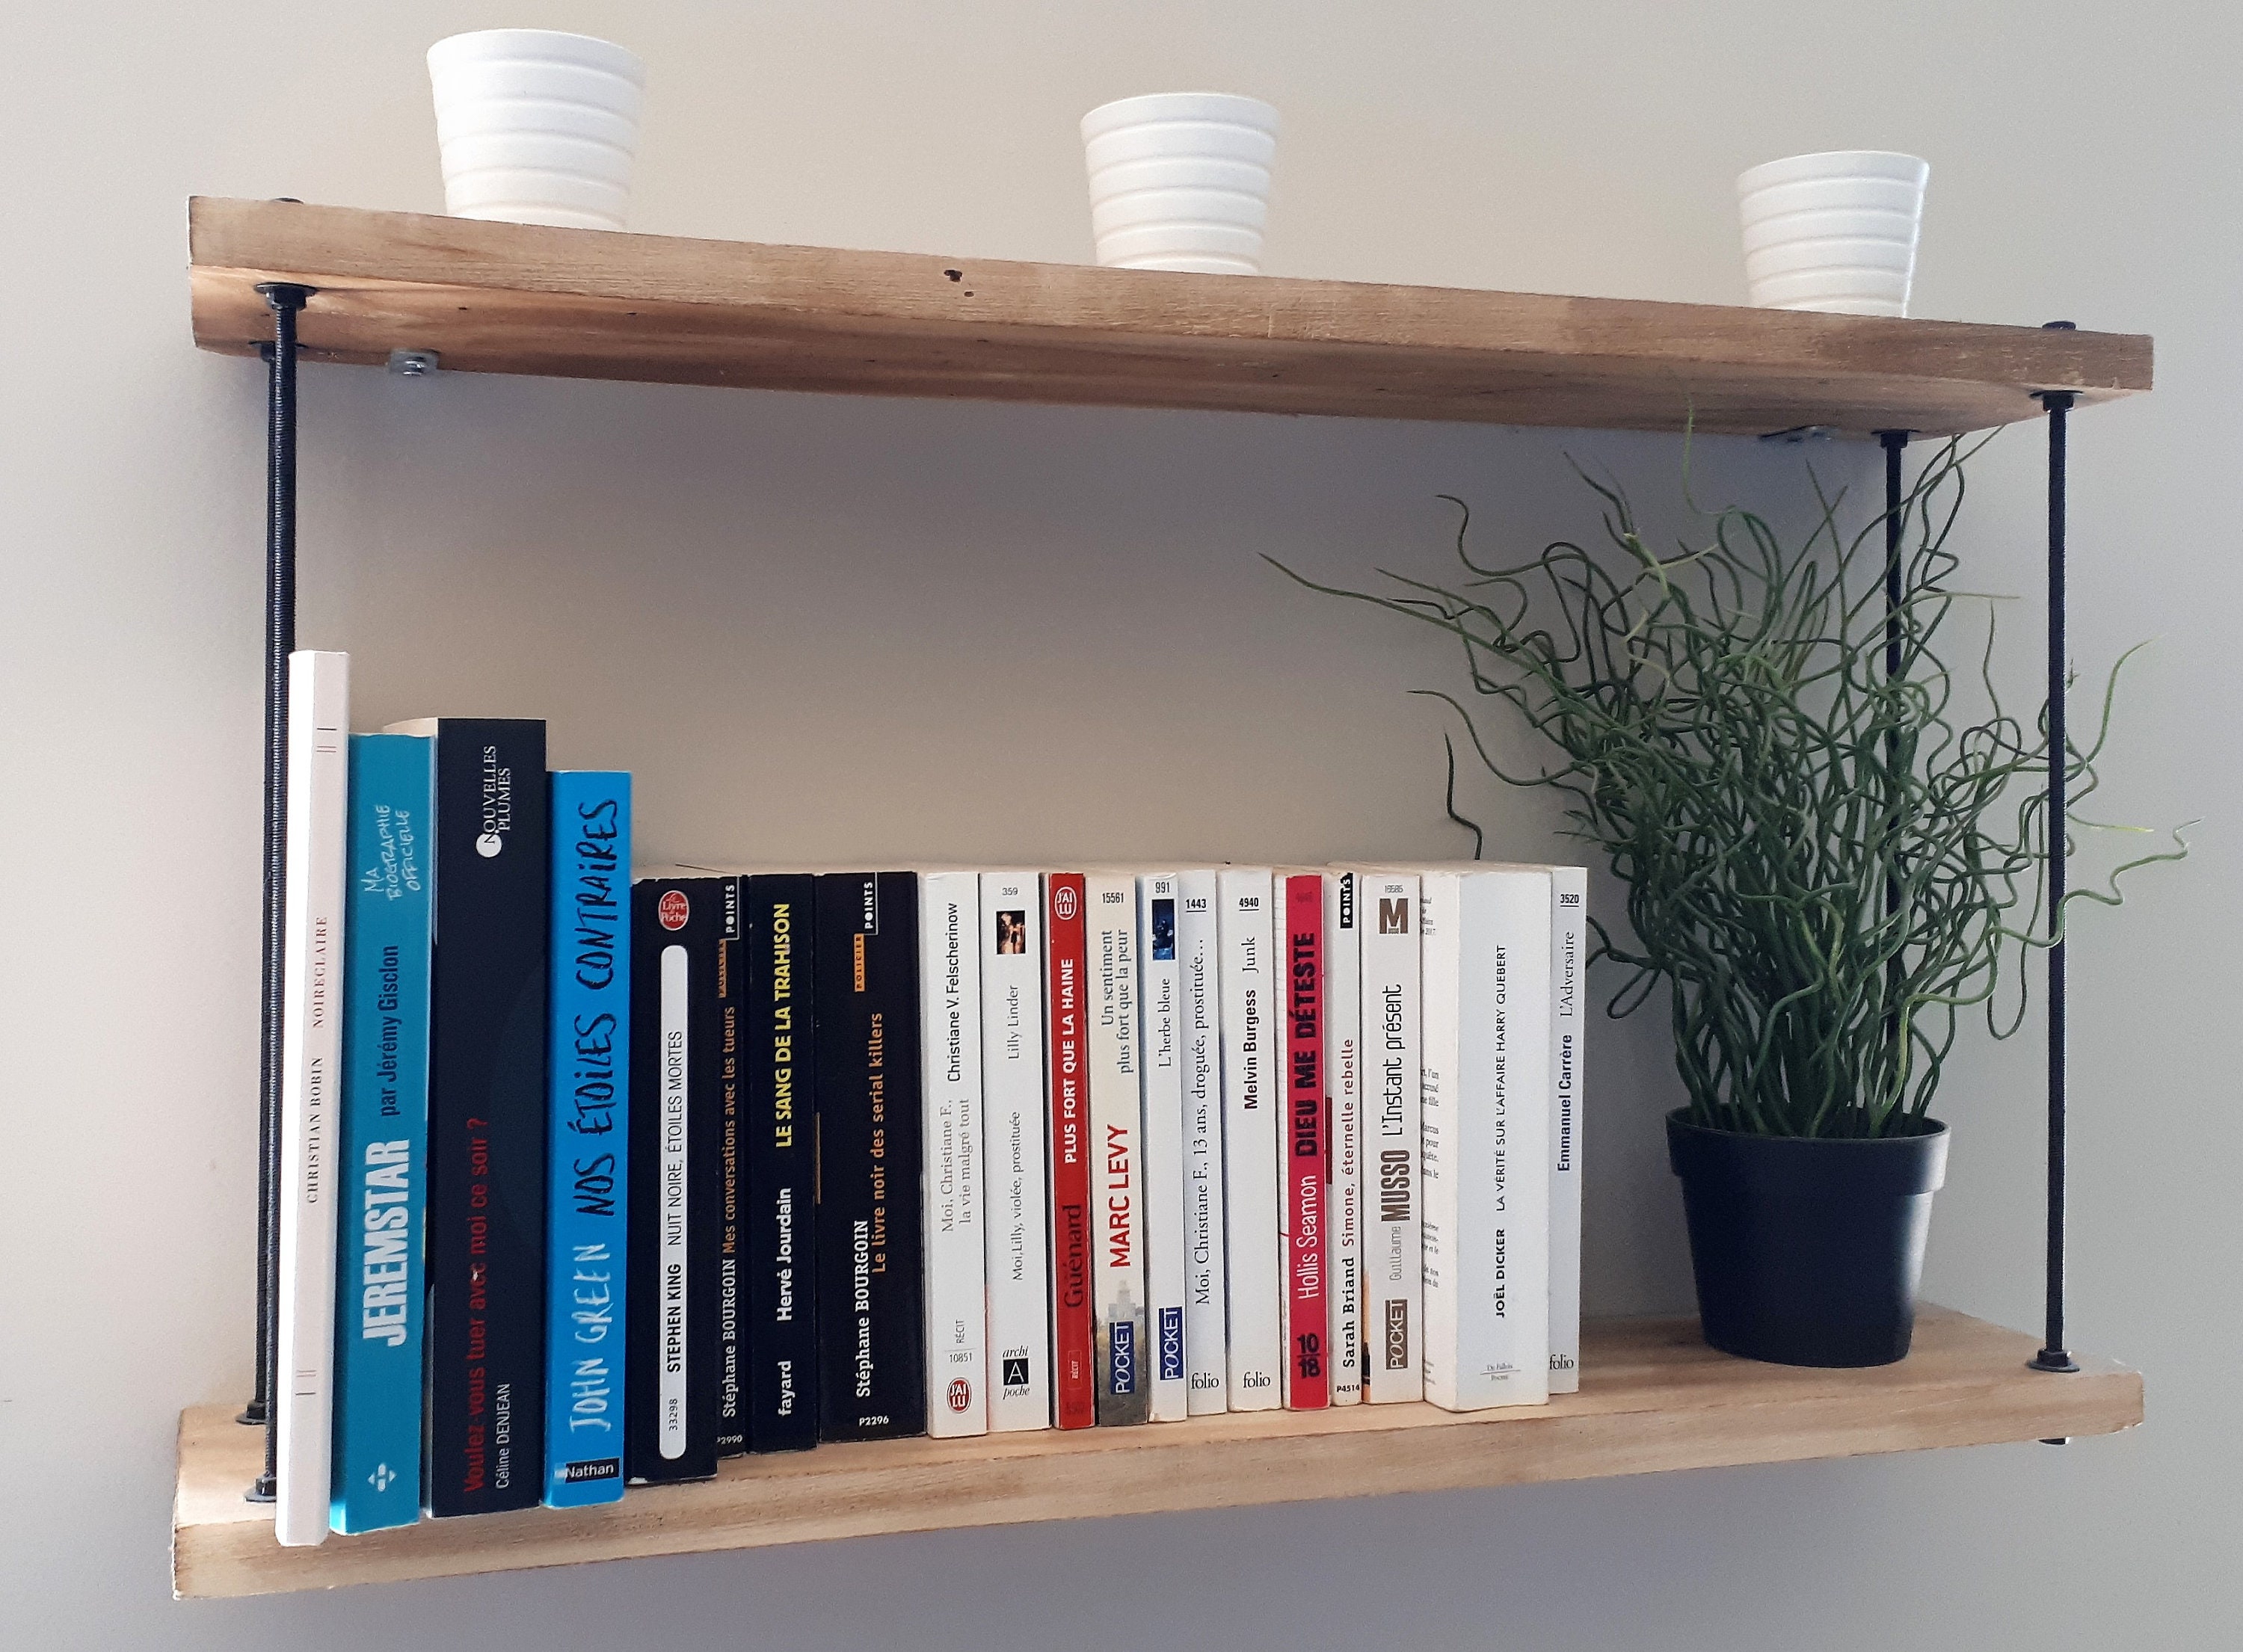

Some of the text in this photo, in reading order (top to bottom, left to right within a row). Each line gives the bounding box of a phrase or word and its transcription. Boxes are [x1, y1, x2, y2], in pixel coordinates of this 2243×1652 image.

[482, 745, 497, 845] NOUVELLES
[498, 767, 511, 832] PLUMES
[361, 867, 384, 893] MA
[375, 804, 403, 901] BIOGRAPHIE
[395, 810, 422, 892] OFFICIELLE
[662, 901, 686, 911] Livre
[725, 884, 735, 933] POINTS
[864, 882, 873, 929] POINTS
[1002, 887, 1018, 896] 359
[1057, 892, 1073, 903] J'AI
[1059, 903, 1072, 915] LU
[1101, 892, 1124, 904] 15561
[1155, 881, 1170, 893] 991
[1185, 899, 1207, 909] 1443
[1239, 897, 1260, 907] 4940
[1342, 878, 1351, 924] POINTS
[1560, 893, 1580, 904] 3520
[944, 902, 960, 1082] Christiane V. Felscherinow
[1100, 930, 1114, 1026] Un sentiment
[1115, 928, 1133, 1074] plus fort que la peur
[1289, 932, 1317, 1039] DÉTESTE
[1559, 931, 1575, 1017] L'Adversaire
[376, 1017, 402, 1083] Jérémy
[773, 903, 792, 1148] LE SANG DE LA TRAHISON
[1007, 984, 1022, 1060] Lilly Linder
[1157, 978, 1172, 1068] L'herbe bleue
[1241, 936, 1259, 1110] Melvin Burgess Junk
[310, 1057, 323, 1107] BOBIN
[1061, 958, 1077, 1164] PLUS FORT QUE LA HAINE
[1190, 1034, 1210, 1100] droguée,
[1293, 1050, 1317, 1088] ME
[1381, 983, 1406, 1137] L'Instant présent
[1493, 945, 1507, 1212] LA VÉRITÉ SUR L'AFFAIRE HARRY QUEBERT
[380, 1088, 400, 1117] par
[1195, 1103, 1209, 1134] ans,
[1294, 1099, 1319, 1157] DIEU
[1557, 1034, 1572, 1172] Emmanuel Carrère
[307, 1113, 321, 1203] CHRISTIAN
[469, 1138, 487, 1177] soir
[868, 1012, 886, 1273] Le livre noir des serial killers
[940, 1121, 953, 1196] Christiane
[957, 1098, 973, 1224] la vie malgré tout
[1009, 1112, 1024, 1218] violée, prostituée
[1193, 1138, 1208, 1156] 13
[470, 1184, 487, 1209] ce
[573, 1153, 615, 1218] NOS
[721, 1007, 739, 1418] Stéphane BOURGOIN Mes conversations avec les tueurs
[1106, 1123, 1131, 1269] MARC LEVY
[1340, 1038, 1356, 1368] Sarah Briand Simone, éternelle rebelle
[1380, 1150, 1411, 1281] Guillaume MUSSO
[363, 1139, 410, 1346] JEREMSTAR
[467, 1215, 487, 1255] moi
[665, 1031, 683, 1431] 33298 STEPHEN KING NUIT NOIRE, ÉTOILES MORTES
[776, 1188, 793, 1321] Hervé Jourdain
[1193, 1185, 1210, 1265] Christiane
[1295, 1174, 1320, 1300] Hollis Seamon
[470, 1263, 486, 1310] avec
[572, 1242, 614, 1345] GREEN
[1193, 1269, 1211, 1305] Moi,
[1492, 1228, 1506, 1319] JOËL DICKER
[466, 1318, 486, 1361] tuer
[854, 1220, 873, 1398] Stéphane BOURGOIN
[1389, 1299, 1404, 1369] POCKET
[949, 1352, 972, 1363] 10851
[1003, 1345, 1029, 1357] archi
[1113, 1321, 1131, 1394] POCKET
[1163, 1307, 1180, 1380] POCKET
[1297, 1333, 1320, 1354] 10
[1297, 1357, 1321, 1380] 18
[1549, 1353, 1575, 1371] folio
[569, 1357, 612, 1433] JOHN
[778, 1360, 796, 1417] fayard
[950, 1383, 967, 1396] J'AI
[952, 1396, 966, 1407] LU
[1003, 1385, 1030, 1400] poche
[1190, 1372, 1219, 1390] folio
[1243, 1371, 1271, 1389] folio
[1336, 1384, 1360, 1393] P4514
[495, 1383, 511, 1491] Céline DENJEAN
[859, 1415, 889, 1426] P2296
[564, 1461, 615, 1480] Nathan
